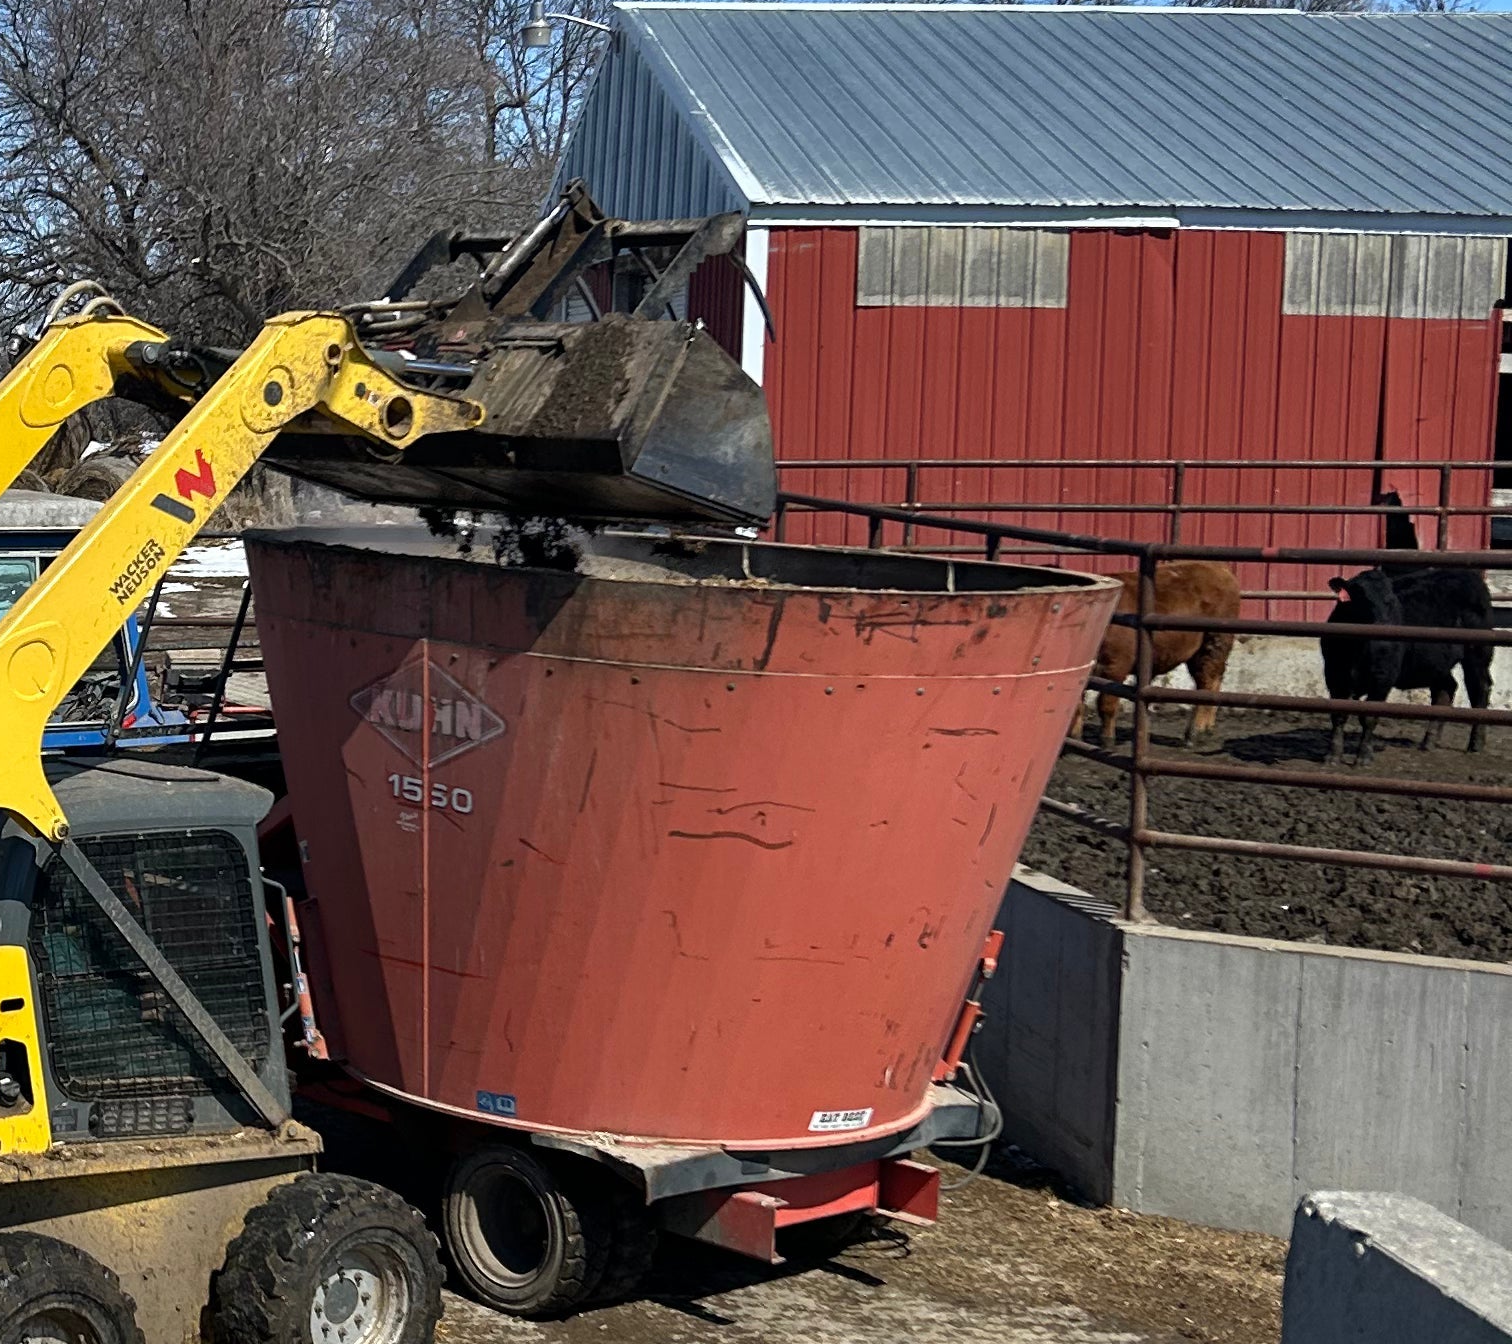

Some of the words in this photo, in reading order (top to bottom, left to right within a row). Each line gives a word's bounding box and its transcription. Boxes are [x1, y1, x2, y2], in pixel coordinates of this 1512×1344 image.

[109, 539, 159, 595] WACKER
[116, 546, 166, 606] NEUSON
[370, 689, 482, 741] KUHN
